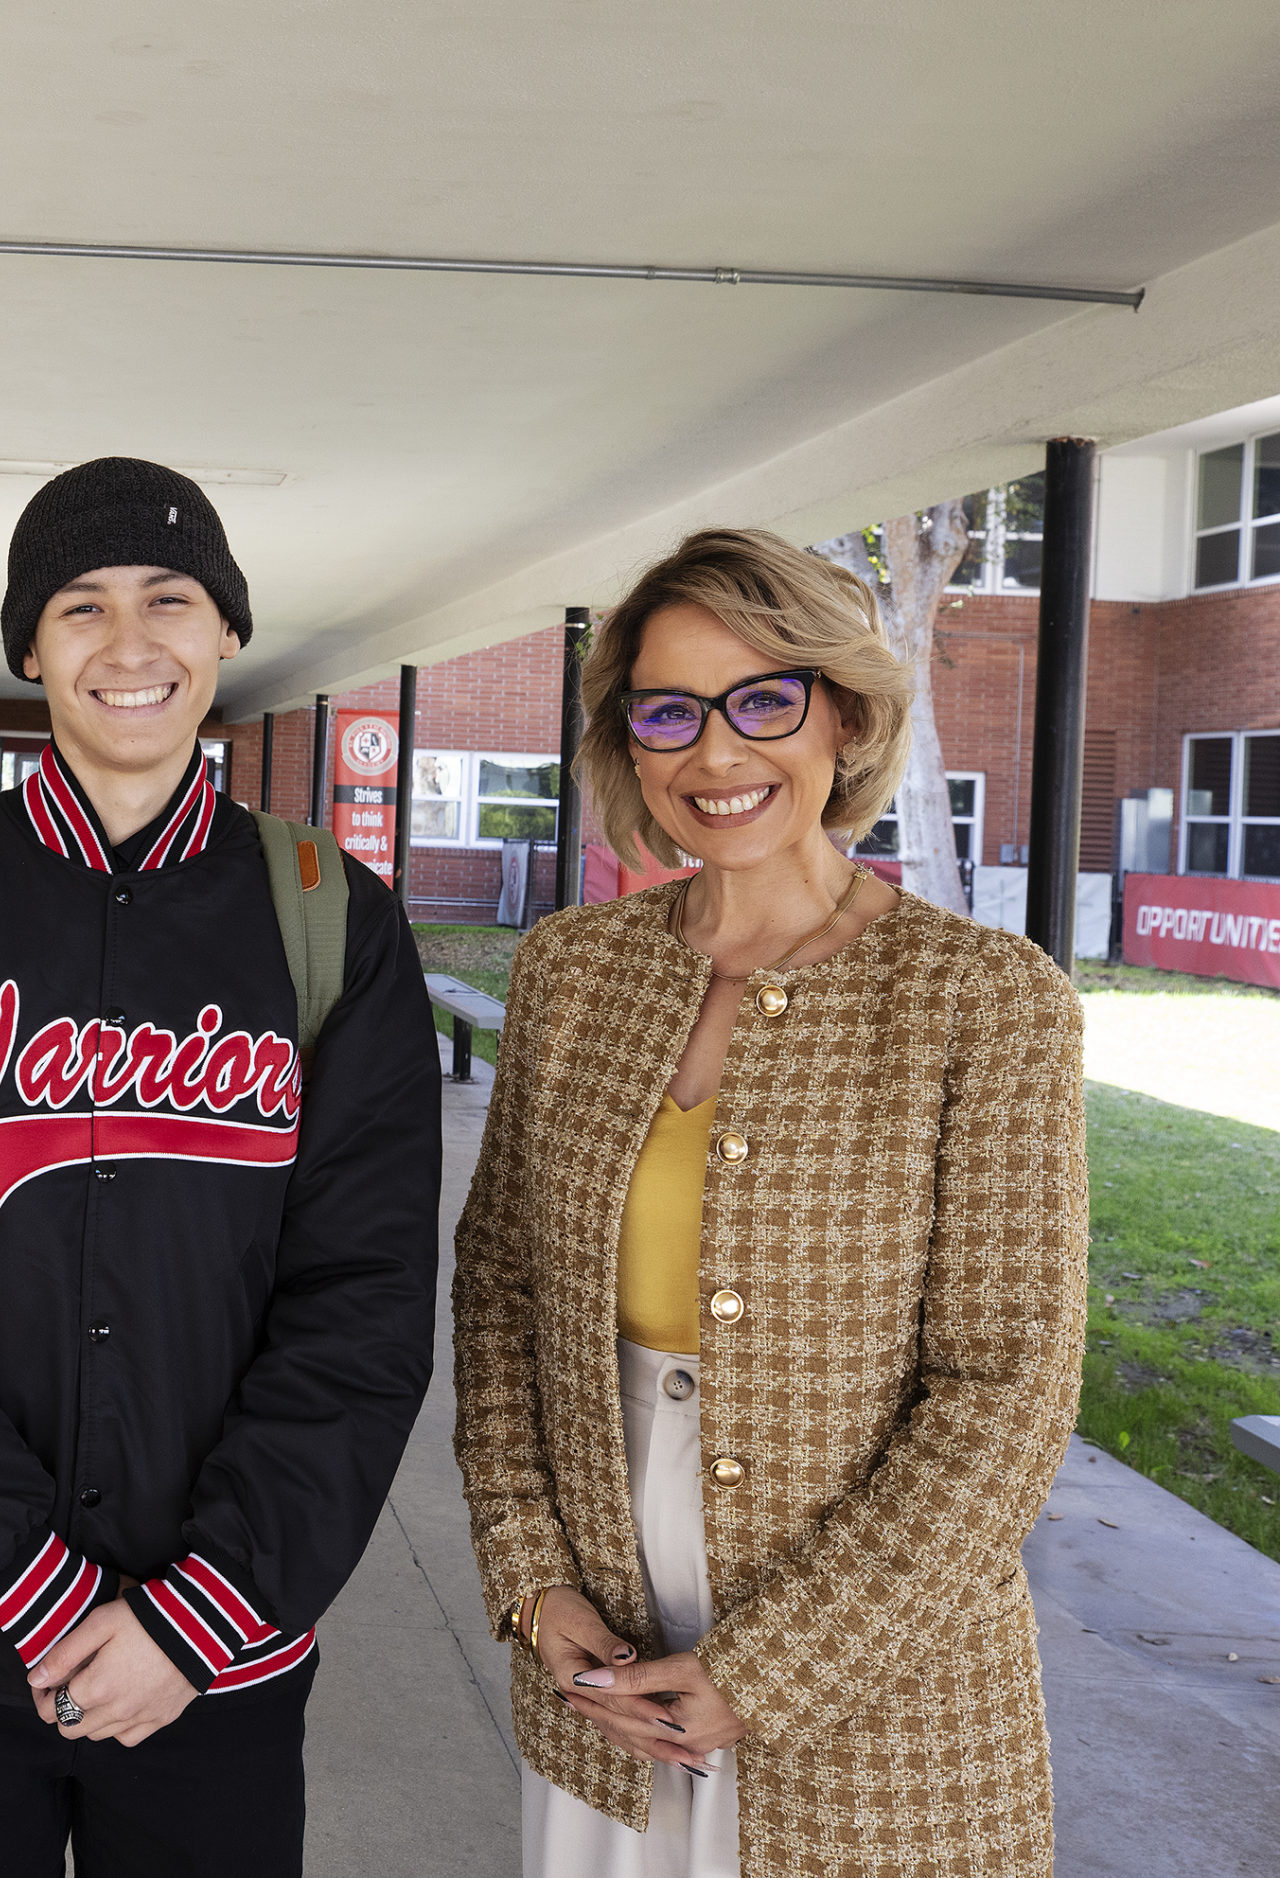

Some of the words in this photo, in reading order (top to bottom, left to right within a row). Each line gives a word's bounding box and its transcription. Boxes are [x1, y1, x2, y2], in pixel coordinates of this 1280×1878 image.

[353, 786, 383, 804] Strives
[352, 811, 361, 827] to
[362, 810, 384, 828] think
[344, 833, 380, 855] critically
[380, 835, 388, 852] &
